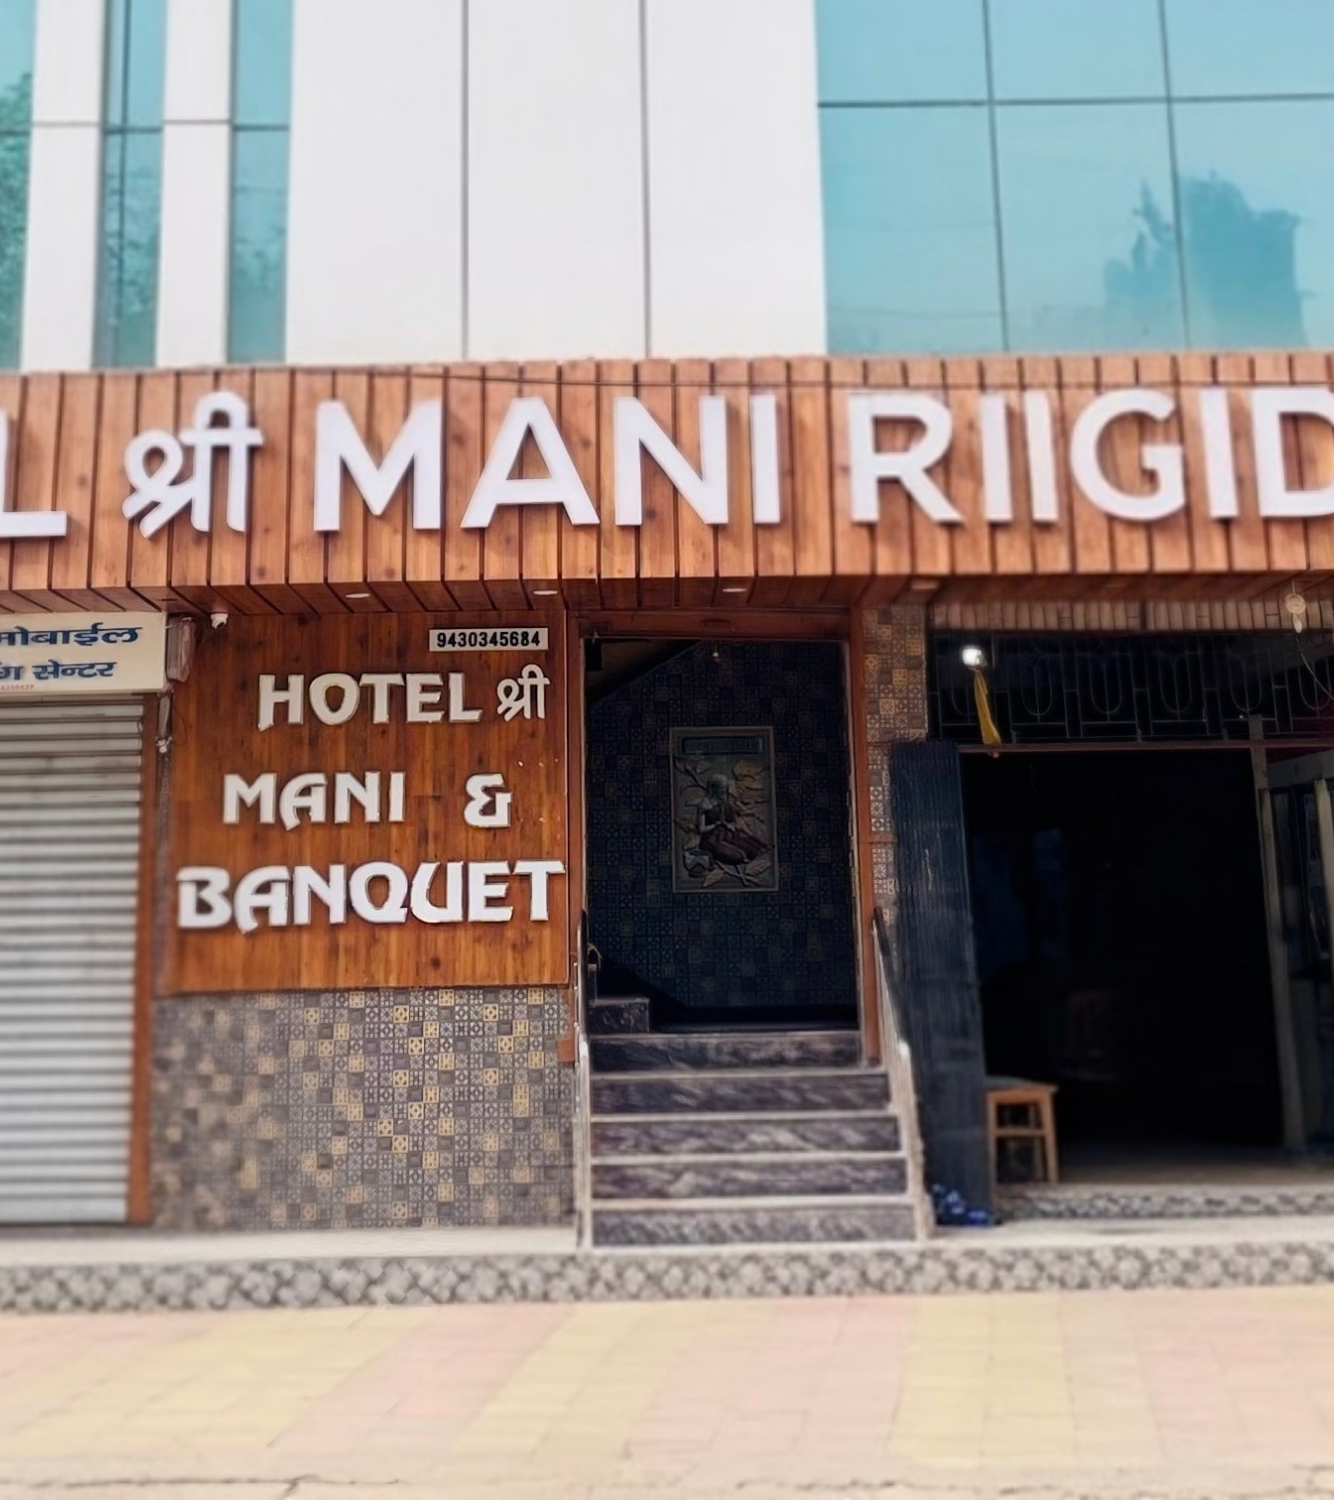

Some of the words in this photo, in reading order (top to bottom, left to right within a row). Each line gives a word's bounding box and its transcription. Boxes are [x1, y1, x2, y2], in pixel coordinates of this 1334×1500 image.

[123, 391, 264, 540] श्री
[313, 393, 780, 532] MANI
[436, 630, 541, 649] 9430345684
[257, 671, 484, 732] HOTEL
[496, 663, 551, 722] श्री
[222, 771, 406, 831] MANI
[464, 773, 513, 828] &
[175, 860, 567, 935] BANQUET
